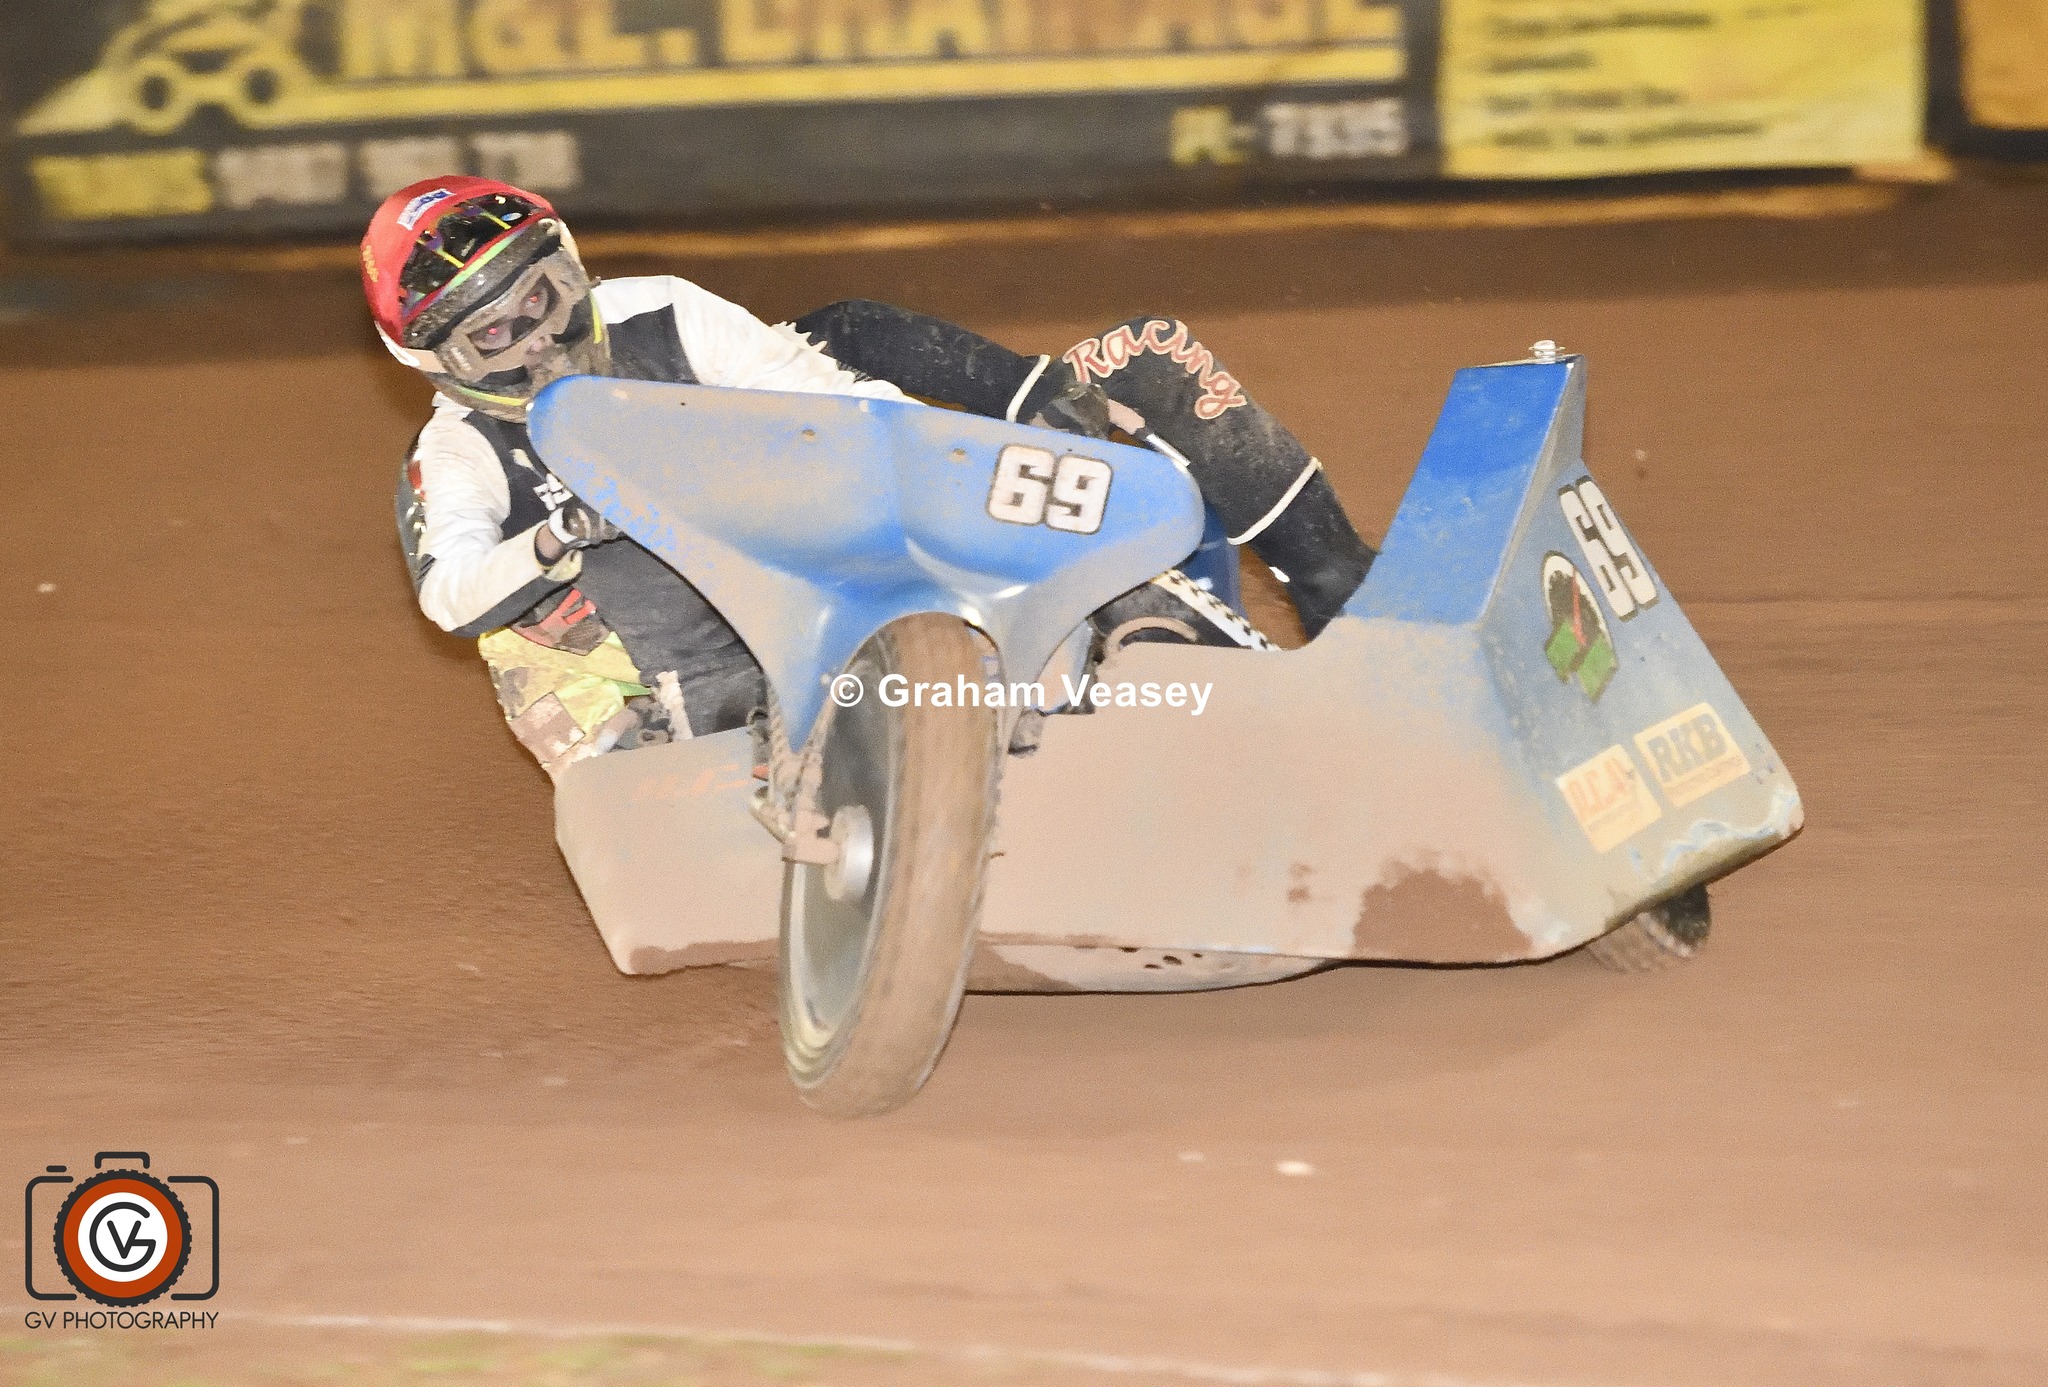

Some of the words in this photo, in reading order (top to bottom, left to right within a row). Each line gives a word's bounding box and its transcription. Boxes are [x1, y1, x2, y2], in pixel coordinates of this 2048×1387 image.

[1062, 319, 1248, 420] Racing
[985, 443, 1114, 536] 69
[1558, 475, 1660, 623] 69
[1647, 712, 1728, 783] RKB
